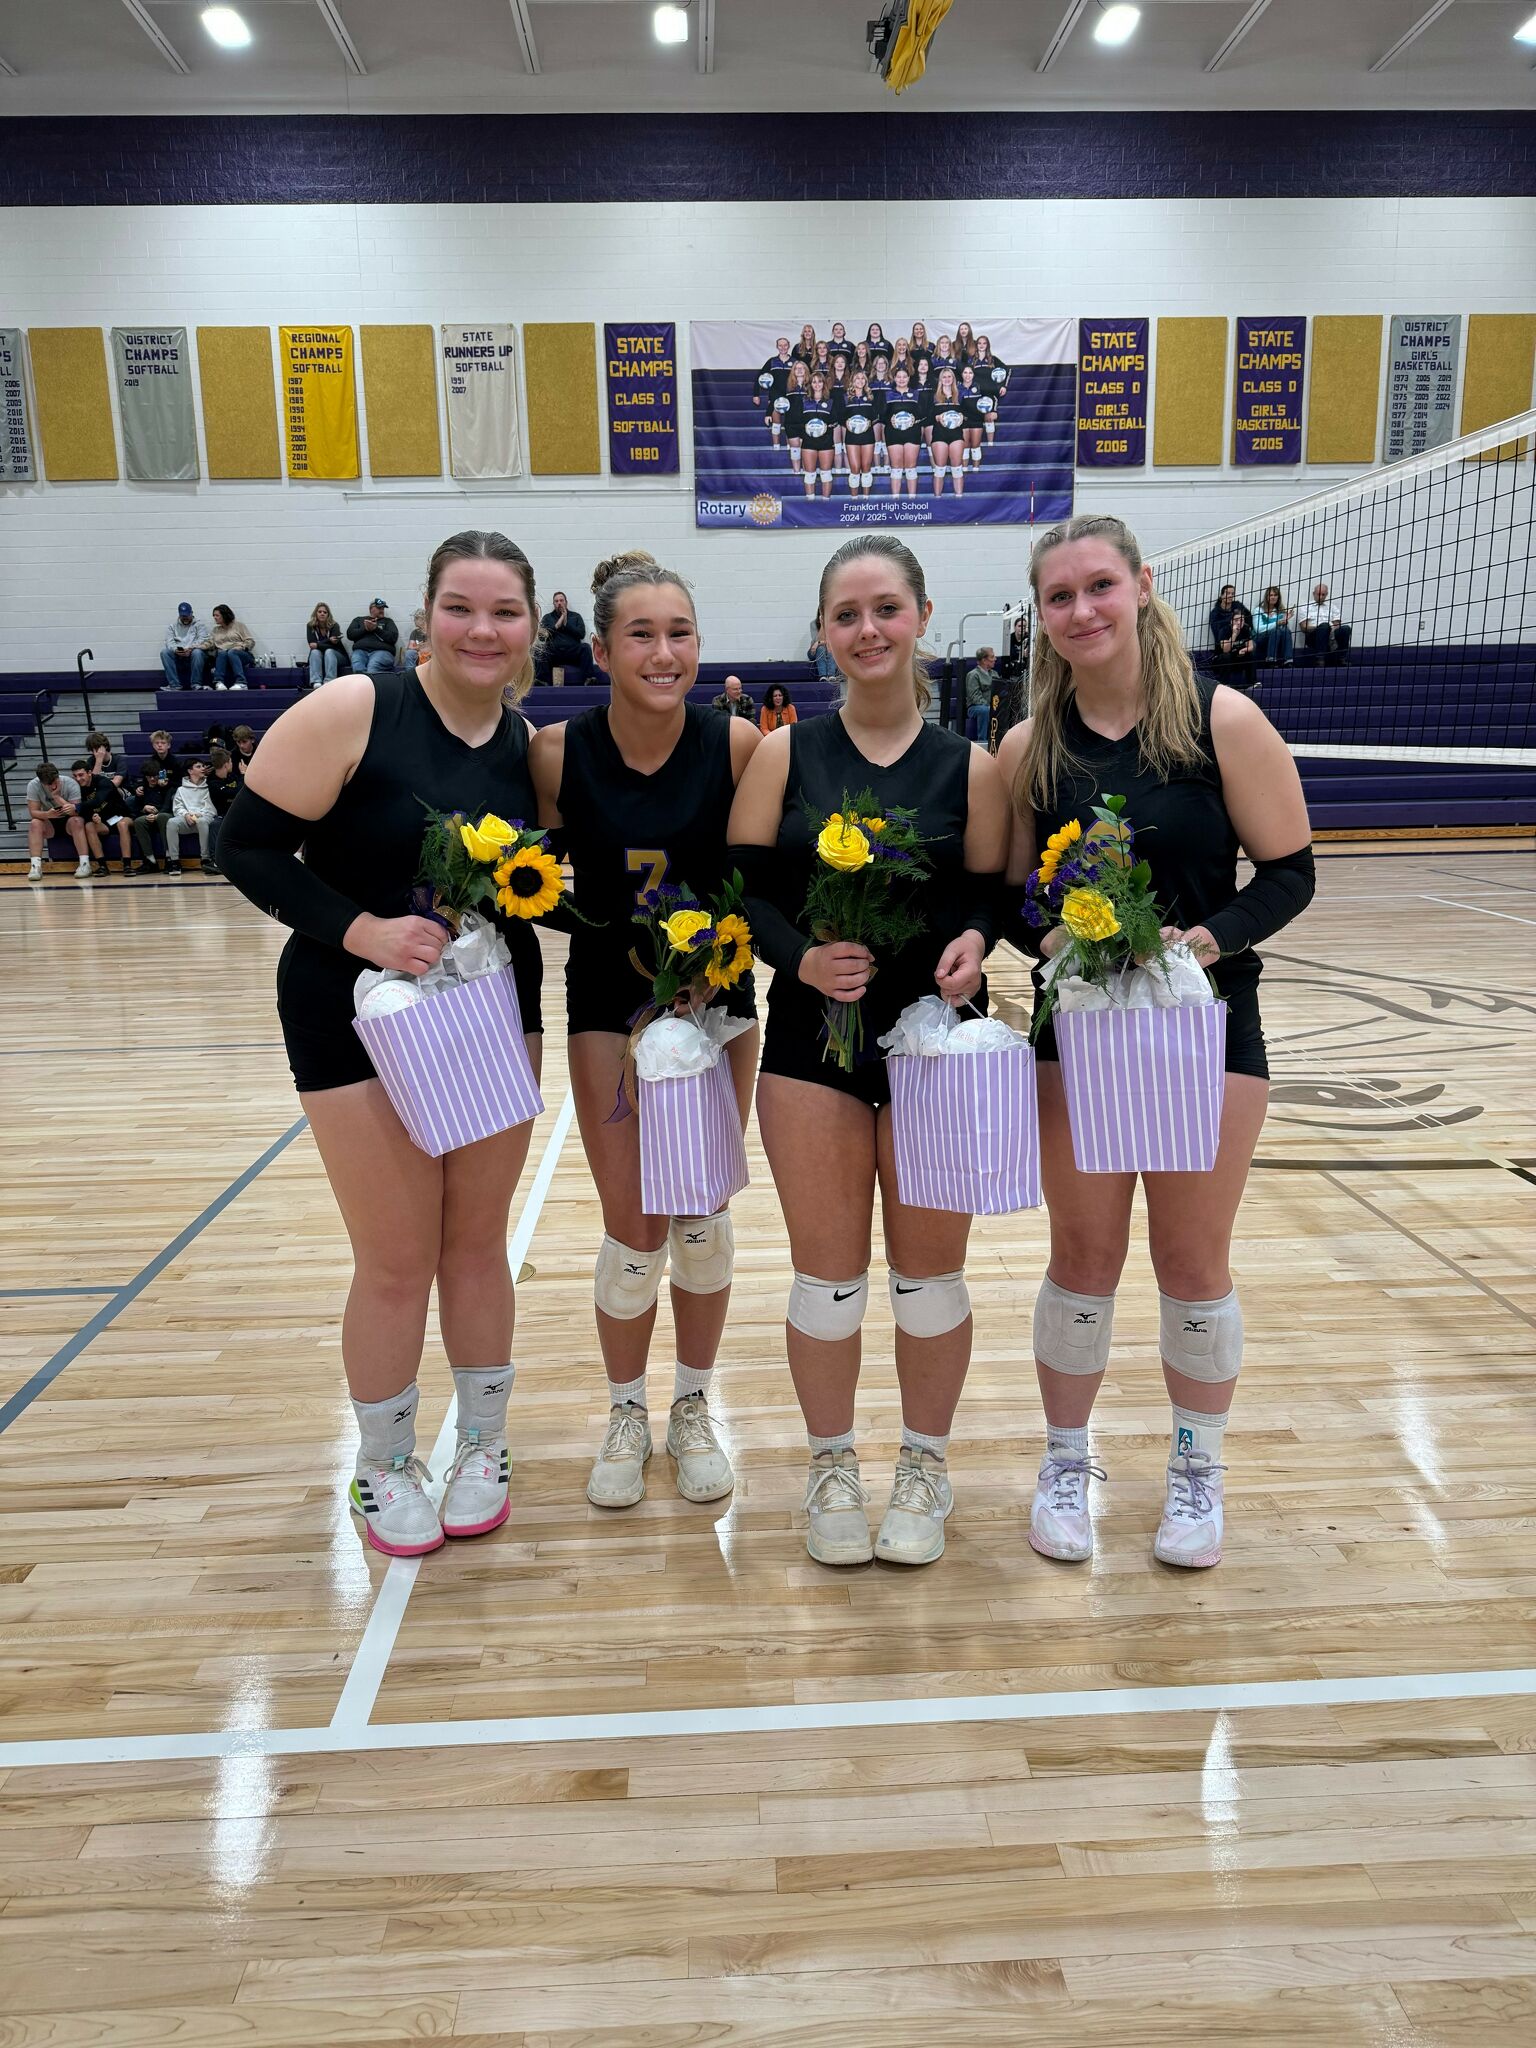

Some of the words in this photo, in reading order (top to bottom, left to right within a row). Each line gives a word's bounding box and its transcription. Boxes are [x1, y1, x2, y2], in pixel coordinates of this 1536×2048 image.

[1404, 321, 1449, 331] DISTRICT
[126, 335, 173, 345] DISTRICT
[291, 333, 341, 344] REGIONAL
[462, 331, 494, 342] STATE
[1091, 331, 1137, 349] STATE
[1248, 330, 1294, 347] STATE
[1400, 335, 1451, 347] CHAMPS
[444, 346, 495, 358] RUNNERS
[498, 345, 513, 357] UP
[616, 337, 665, 354] STATE
[125, 349, 179, 361] CHAMPS
[290, 347, 343, 359] CHAMPS
[1411, 350, 1438, 360] GIRL'S
[455, 361, 505, 373] SOFTBALL
[1082, 354, 1145, 372] CHAMPS
[1239, 353, 1301, 370] CHAMPS
[1394, 361, 1453, 371] BASKETBALL
[127, 364, 179, 375] SOFTBALL
[292, 363, 343, 374] SOFTBALL
[609, 360, 673, 377] CHAMPS
[124, 379, 140, 387] 2019
[1394, 374, 1409, 382] 1973
[1085, 382, 1124, 394] CLASS
[1132, 381, 1140, 394] D
[1242, 381, 1282, 393] CLASS
[1288, 380, 1297, 393] D
[615, 392, 655, 405] CLASS
[662, 392, 671, 405] D
[1436, 393, 1451, 401] 2022
[613, 420, 675, 433] SOFTBALL
[1078, 417, 1146, 431] BASKETBALL
[1236, 418, 1301, 431] BASKETBALL
[292, 444, 307, 452] 2007
[1095, 439, 1128, 453] 2006
[1252, 437, 1284, 451] 2005
[1411, 439, 1426, 447] 2017
[11, 446, 27, 454] 2016
[292, 453, 308, 461] 2013
[700, 502, 746, 517] Rotary
[843, 503, 880, 511] Frankfort
[881, 503, 900, 512] High
[901, 502, 929, 511] School
[840, 514, 860, 522] 2024
[866, 513, 887, 521] 2025
[894, 512, 932, 522] Volleyball
[625, 848, 671, 907] 7
